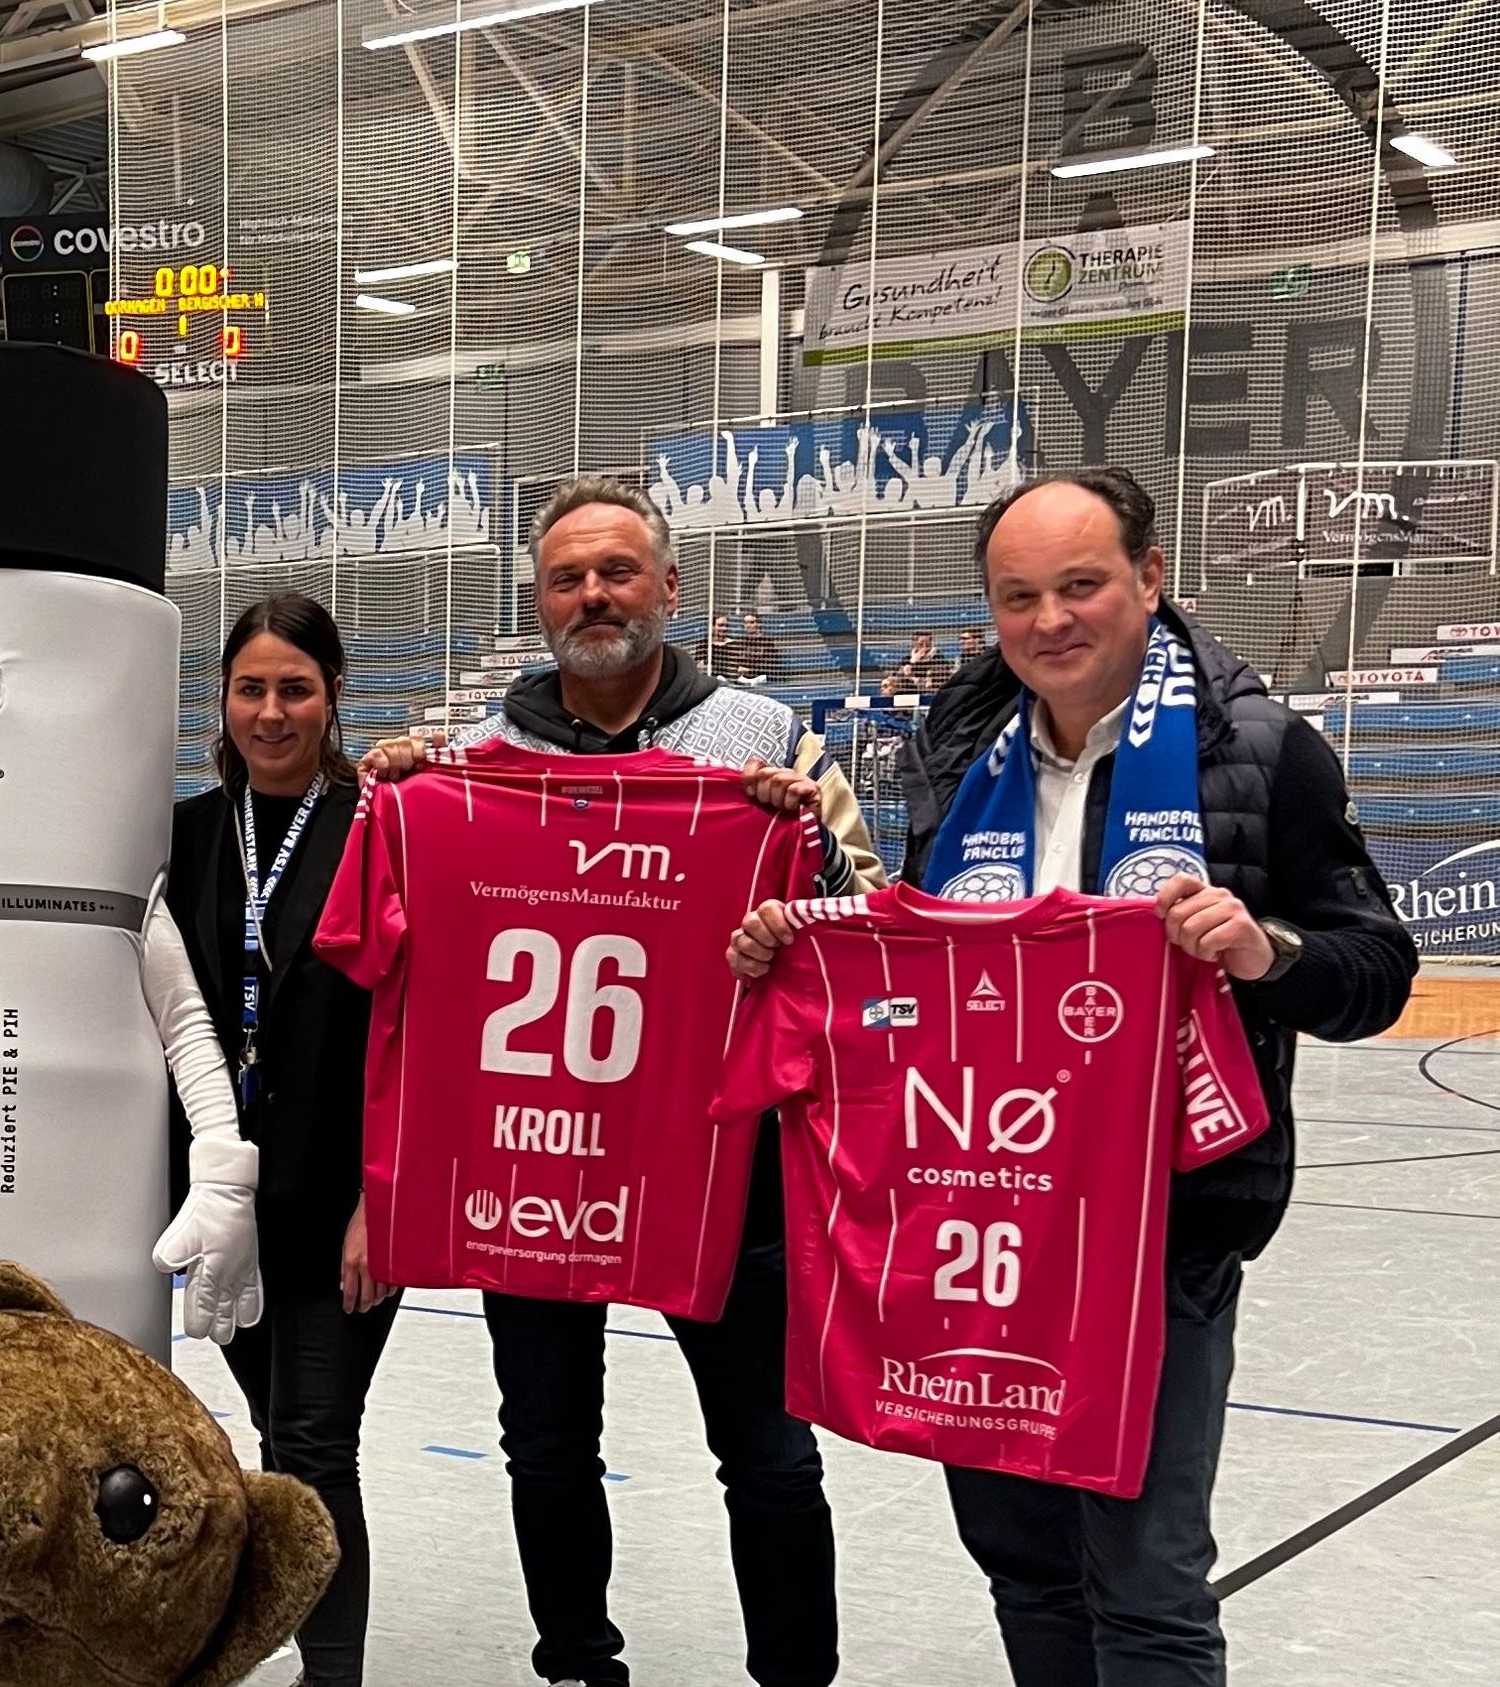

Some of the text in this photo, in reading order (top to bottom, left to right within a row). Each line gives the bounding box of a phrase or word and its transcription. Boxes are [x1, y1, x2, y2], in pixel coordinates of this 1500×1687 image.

[53, 220, 205, 255] covestro
[1080, 244, 1164, 267] THERAPIE
[843, 254, 1001, 310] Gesundheit
[154, 359, 238, 383] SELECT
[1359, 671, 1425, 684] TOYOTA
[270, 847, 291, 872] TSV
[282, 806, 310, 849] BAYER
[1, 897, 96, 912] ILLUMINATES
[469, 881, 682, 911] VermögensManufaktur
[244, 985, 256, 1011] TSV
[480, 928, 647, 1084] 26
[890, 1003, 917, 1015] TSV
[966, 1000, 1006, 1011] SELECT
[1062, 1006, 1118, 1017] BAYER
[1, 1008, 19, 1194] Reduziert PIE & PIH
[493, 1104, 606, 1157] KROLL
[907, 1165, 1053, 1192] cosmetics
[510, 1185, 629, 1243] evd
[466, 1240, 622, 1266] energieversorgung dormagen
[933, 1219, 1022, 1308] 26
[878, 1356, 1067, 1416] RheinLand
[875, 1399, 1058, 1441] VERSICHERUNGSGRUPPE
